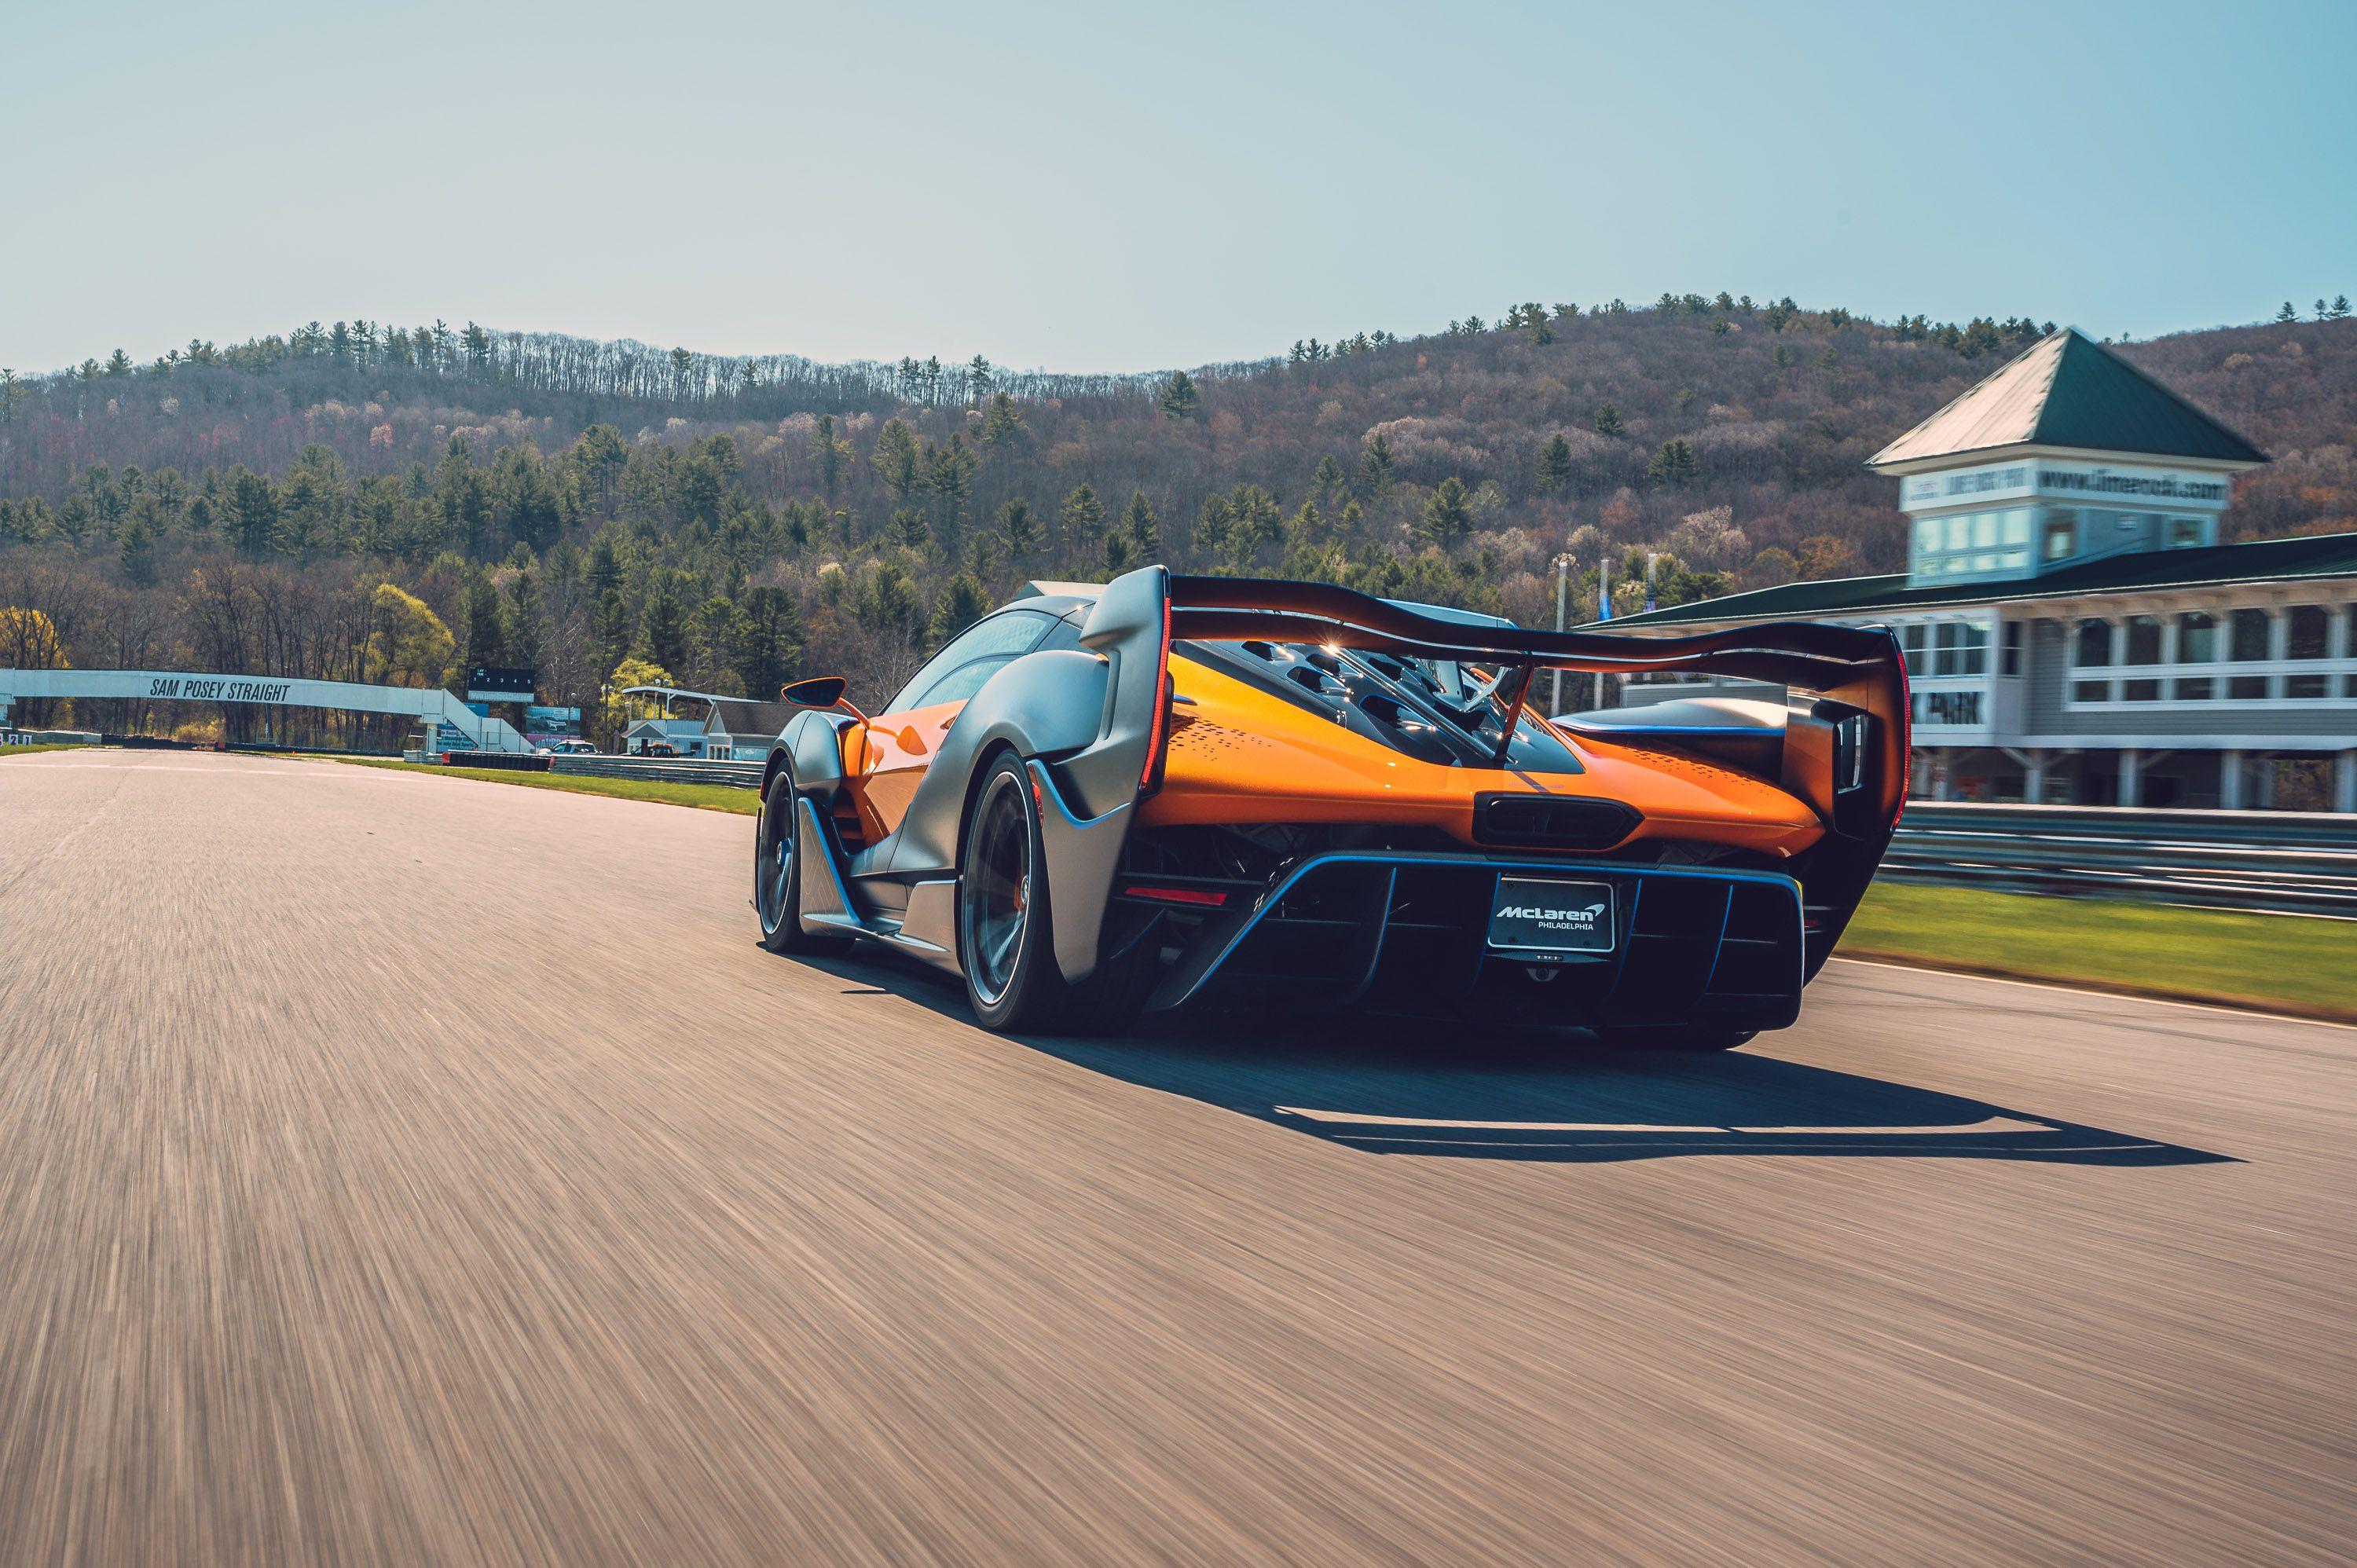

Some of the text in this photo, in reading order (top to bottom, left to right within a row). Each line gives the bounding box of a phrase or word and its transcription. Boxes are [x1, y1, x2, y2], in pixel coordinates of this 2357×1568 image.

[150, 678, 291, 702] SAM POSEY STRAIGHT
[10, 735, 16, 745] 2
[25, 736, 30, 745] 1
[1496, 906, 1593, 921] McLaren
[1538, 921, 1593, 931] PHILADELPHIA
